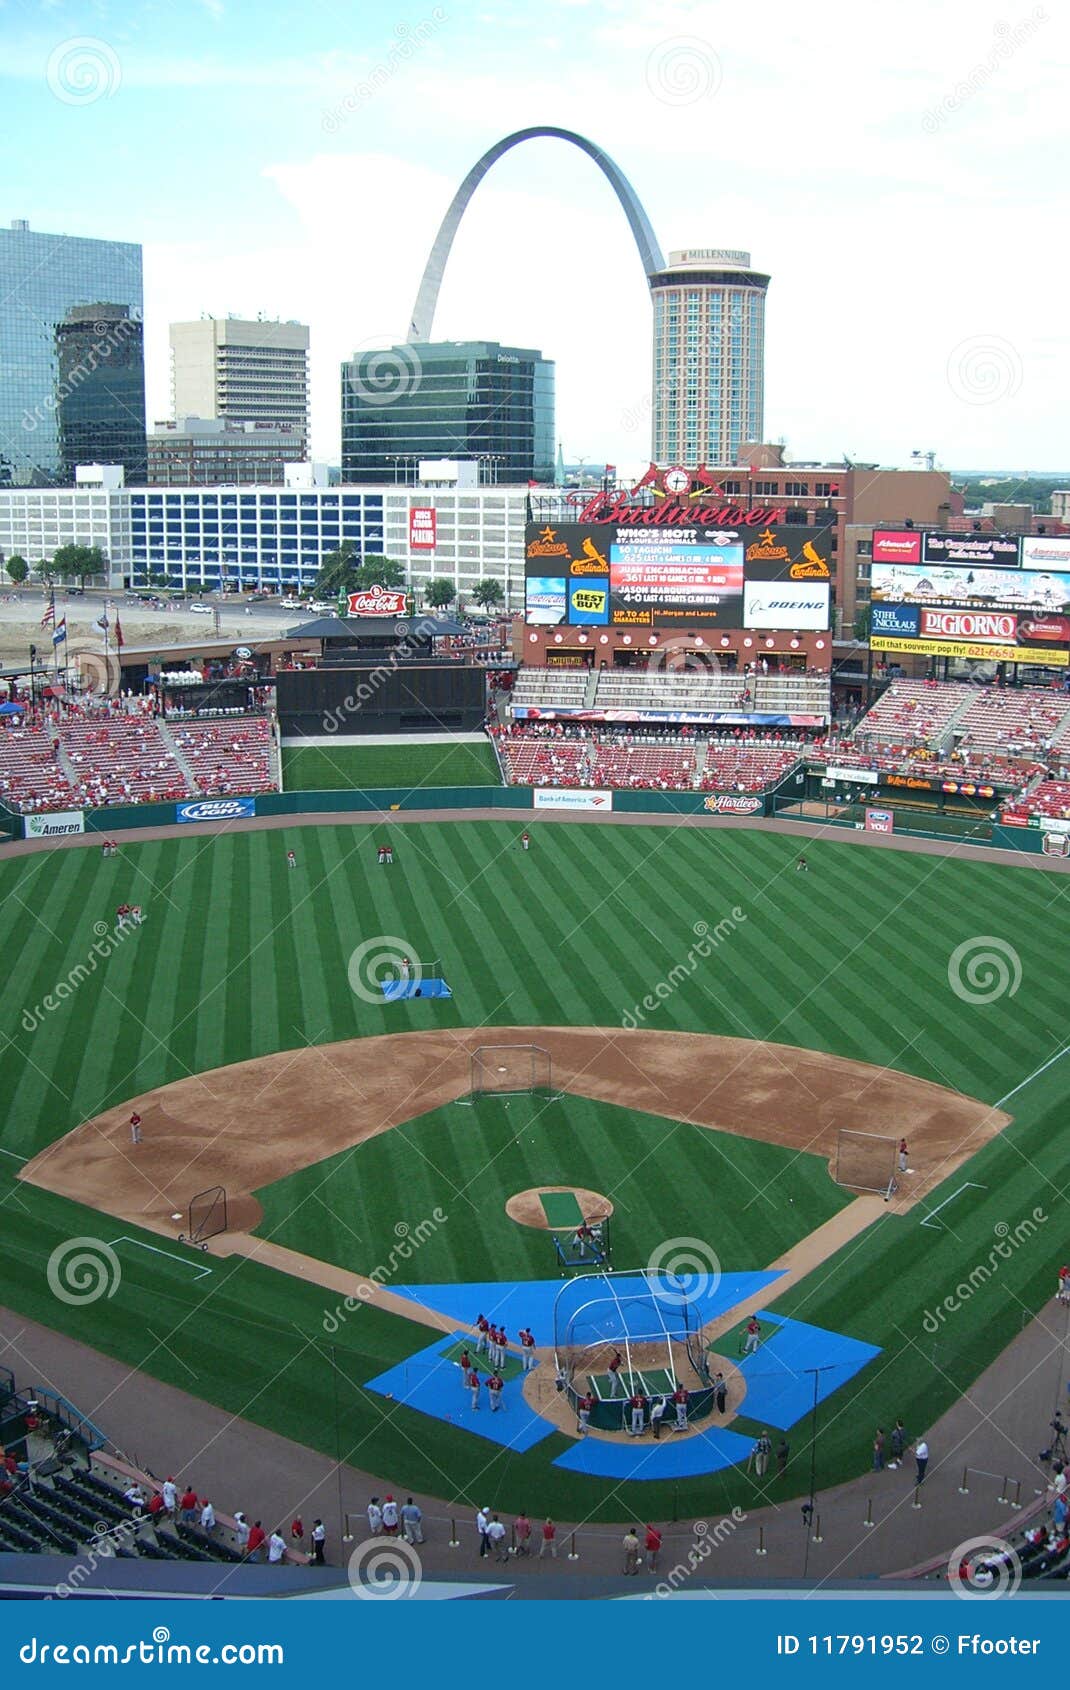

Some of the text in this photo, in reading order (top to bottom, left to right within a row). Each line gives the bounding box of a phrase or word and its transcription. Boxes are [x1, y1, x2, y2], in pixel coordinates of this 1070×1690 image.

[688, 250, 746, 260] MILLENNIUM
[567, 490, 787, 526] Budweiser
[616, 528, 660, 538] WHO'S
[662, 529, 697, 539] HOT?
[790, 563, 830, 579] Cardinals
[618, 586, 649, 594] JASON
[576, 593, 604, 602] BEST
[623, 594, 642, 602] 4-0
[577, 601, 601, 609] BUY
[768, 601, 825, 609] BOEING
[905, 597, 941, 605] COURSES
[988, 602, 1013, 610] LOUIS
[1015, 604, 1063, 613] CARDINALS
[614, 610, 627, 618] UP
[875, 618, 917, 630] NICOLAUS
[871, 639, 886, 648] Sell
[887, 640, 902, 649] that
[903, 642, 937, 651] souvenir
[937, 645, 952, 654] pop
[953, 644, 967, 655] fly!
[203, 801, 239, 811] BUD
[199, 807, 246, 818] LIGHT
[42, 824, 80, 836] Ameren
[871, 823, 888, 831] YOU
